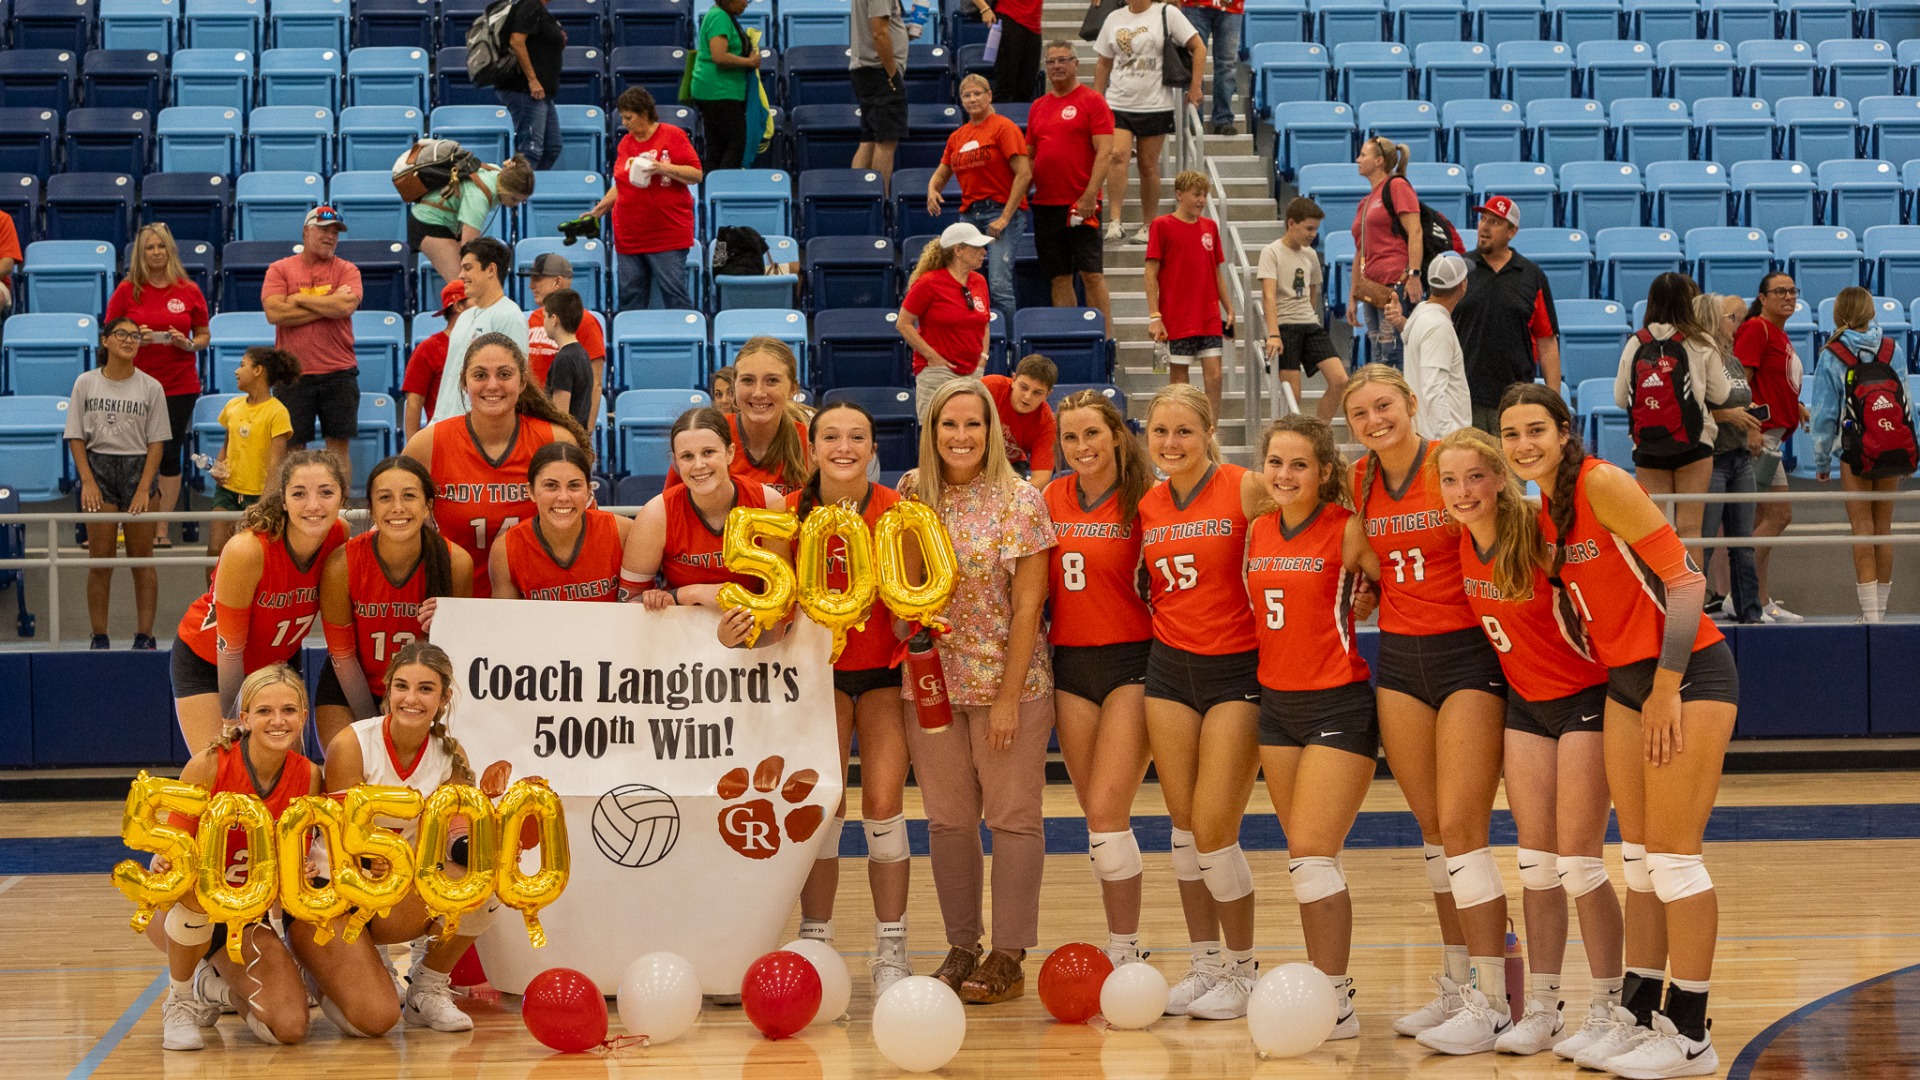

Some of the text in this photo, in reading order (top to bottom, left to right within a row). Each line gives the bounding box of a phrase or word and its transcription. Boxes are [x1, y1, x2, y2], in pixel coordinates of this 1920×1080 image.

[1872, 402, 1894, 411] adidas
[487, 483, 529, 503] TIGE
[1053, 522, 1133, 540] DY TIGERS
[1144, 519, 1233, 547] ADY TIGERS
[716, 496, 959, 632] 500
[1061, 552, 1086, 592] 8
[1154, 554, 1199, 592] 15
[1249, 557, 1325, 573] ADY TIGERS
[1388, 547, 1426, 584] 11
[257, 586, 319, 609] LADY TIG
[521, 575, 619, 601] ADY TIGERS
[1464, 577, 1478, 598] DY
[392, 601, 423, 618] TIG
[1264, 588, 1286, 630] 5
[270, 613, 315, 647] 17
[1481, 615, 1513, 653] 9
[468, 657, 800, 710] Coach Langford's
[533, 715, 734, 760] 500th Win!
